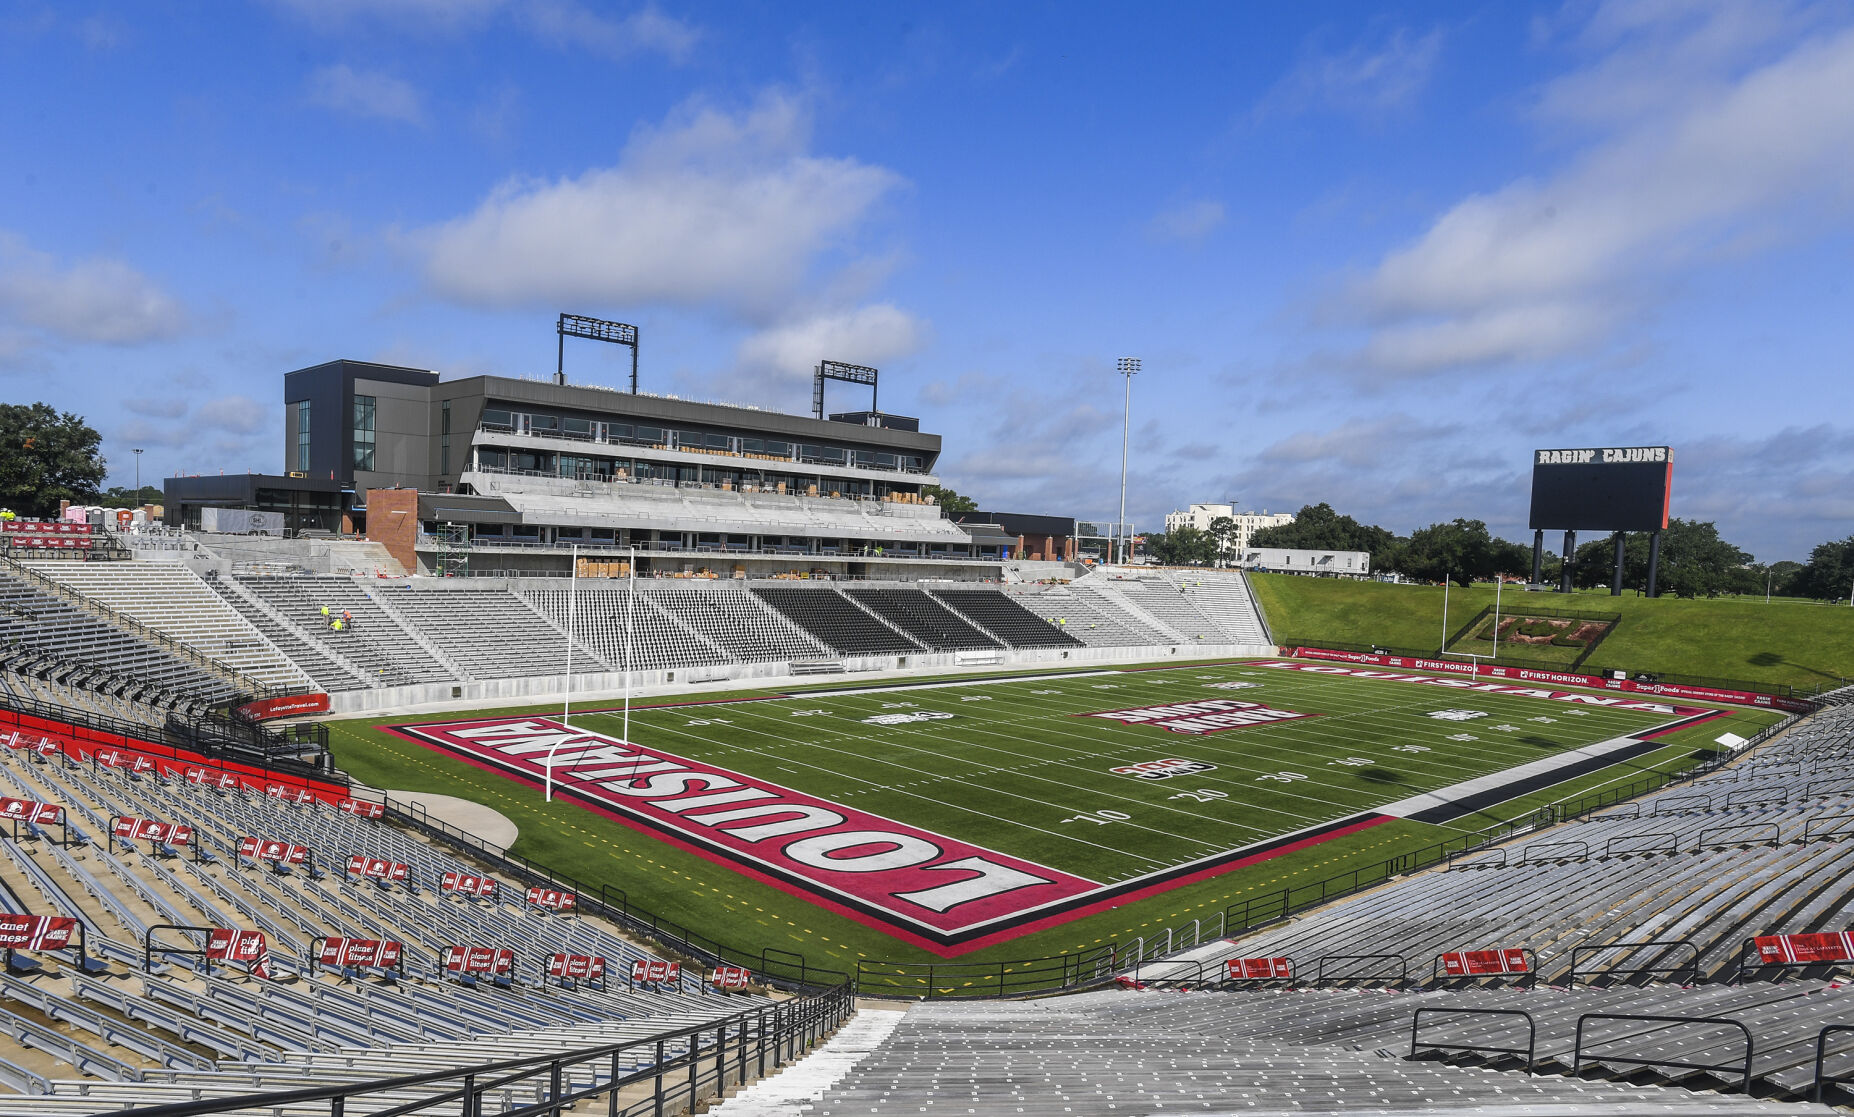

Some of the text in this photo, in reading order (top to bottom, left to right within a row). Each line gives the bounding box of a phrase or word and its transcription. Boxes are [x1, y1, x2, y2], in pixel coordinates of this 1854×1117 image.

[1538, 447, 1666, 464] RAGIN' CAJUNS
[1529, 672, 1550, 680] FIRST
[270, 702, 319, 712] LafayetteTravel.com
[1262, 772, 1308, 782] 30
[1176, 789, 1229, 802] 20
[446, 721, 1057, 913] LOUISIANA
[1073, 809, 1131, 825] 10
[0, 922, 29, 932] anet
[0, 934, 29, 943] ness
[348, 944, 374, 953] planet
[348, 952, 373, 961] fitness
[470, 952, 491, 960] planet
[470, 960, 490, 968] fitness
